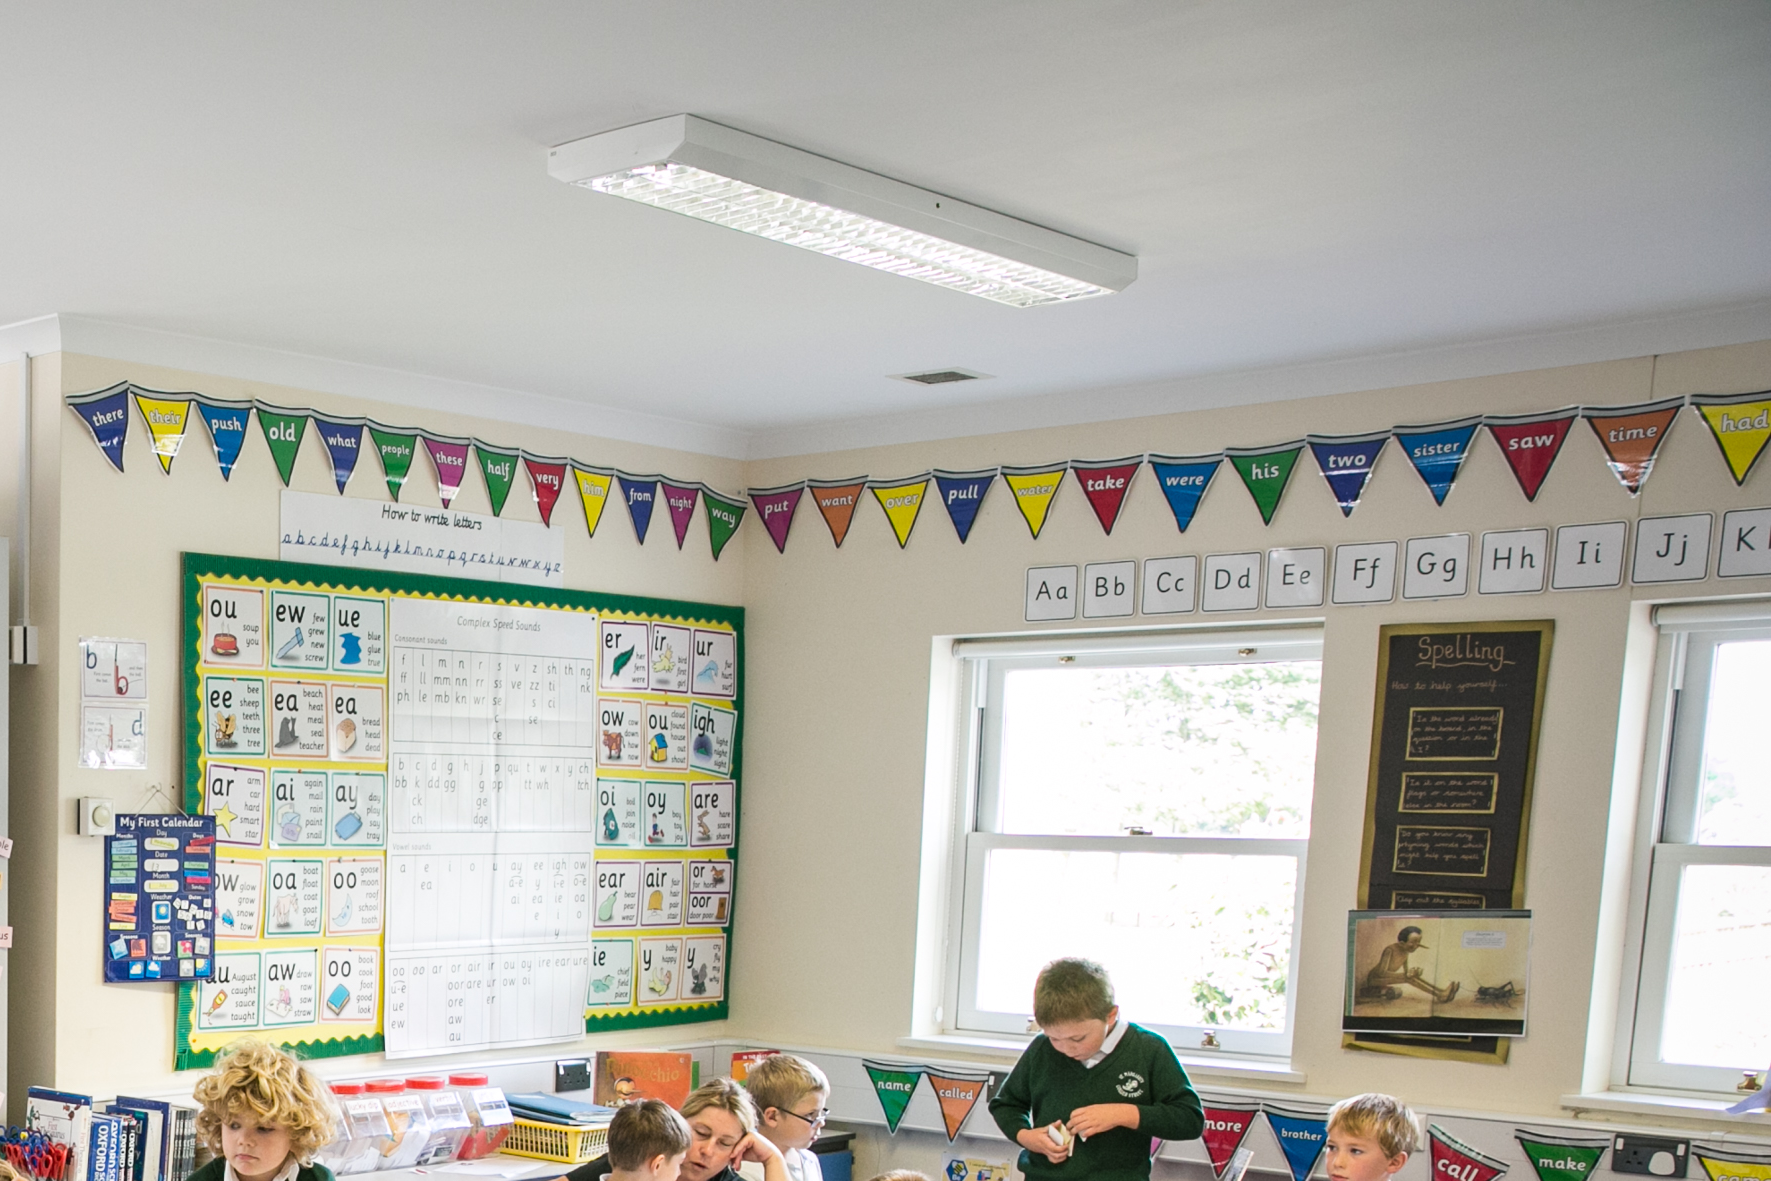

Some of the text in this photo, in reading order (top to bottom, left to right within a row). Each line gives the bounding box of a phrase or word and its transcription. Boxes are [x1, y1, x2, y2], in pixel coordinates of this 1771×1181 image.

[92, 408, 124, 427] there
[148, 410, 181, 425] their
[210, 416, 242, 433] push
[1721, 409, 1769, 433] had
[269, 422, 296, 442] old
[1609, 425, 1658, 443] time
[327, 433, 357, 449] what
[381, 442, 410, 457] people
[1413, 440, 1460, 457] sister
[1508, 433, 1554, 451] saw
[436, 451, 463, 467] these
[1327, 453, 1366, 468] two
[487, 460, 511, 481] half
[1251, 464, 1279, 481] his
[536, 472, 559, 490] very
[582, 479, 605, 497] him
[1087, 475, 1125, 492] take
[1165, 474, 1204, 487] were
[629, 487, 652, 505] from
[948, 485, 978, 505] pull
[1017, 484, 1053, 497] water
[670, 495, 692, 512] night
[764, 500, 789, 519] put
[822, 494, 853, 508] want
[885, 493, 918, 510] over
[382, 504, 482, 530] How to write letters
[711, 506, 736, 528] way
[210, 599, 238, 619] ou
[275, 604, 306, 623] ew
[338, 609, 361, 628] ue
[457, 616, 541, 632] Complex Speed Sounds
[605, 632, 622, 649] er
[654, 631, 666, 651] ir
[696, 640, 713, 657] ur
[1418, 634, 1505, 672] Spelling
[303, 689, 323, 698] beach
[1430, 681, 1451, 692] help
[209, 690, 233, 709] ee
[239, 698, 260, 710] sheep
[274, 692, 298, 712] ea
[335, 696, 357, 715] ea
[602, 710, 624, 727] ow
[649, 714, 668, 730] ou
[694, 709, 715, 737] igh
[211, 776, 235, 796] ar
[275, 779, 296, 801] ai
[335, 783, 358, 810] ay
[600, 786, 616, 806] oi
[694, 792, 718, 809] are
[647, 795, 666, 815] oy
[120, 816, 203, 830] My First Calendar
[334, 871, 357, 889] oo
[598, 872, 625, 888] ear
[646, 868, 667, 888] air
[693, 865, 705, 878] or
[273, 872, 297, 890] oa
[692, 895, 711, 908] oor
[593, 947, 606, 966] ie
[231, 972, 257, 982] August
[268, 963, 296, 981] aw
[328, 960, 351, 977] oo
[878, 1080, 911, 1092] name
[939, 1087, 974, 1101] called
[1204, 1119, 1242, 1133] more
[1281, 1128, 1322, 1141] brother
[96, 1125, 109, 1172] OXFORD
[1539, 1156, 1586, 1171] make
